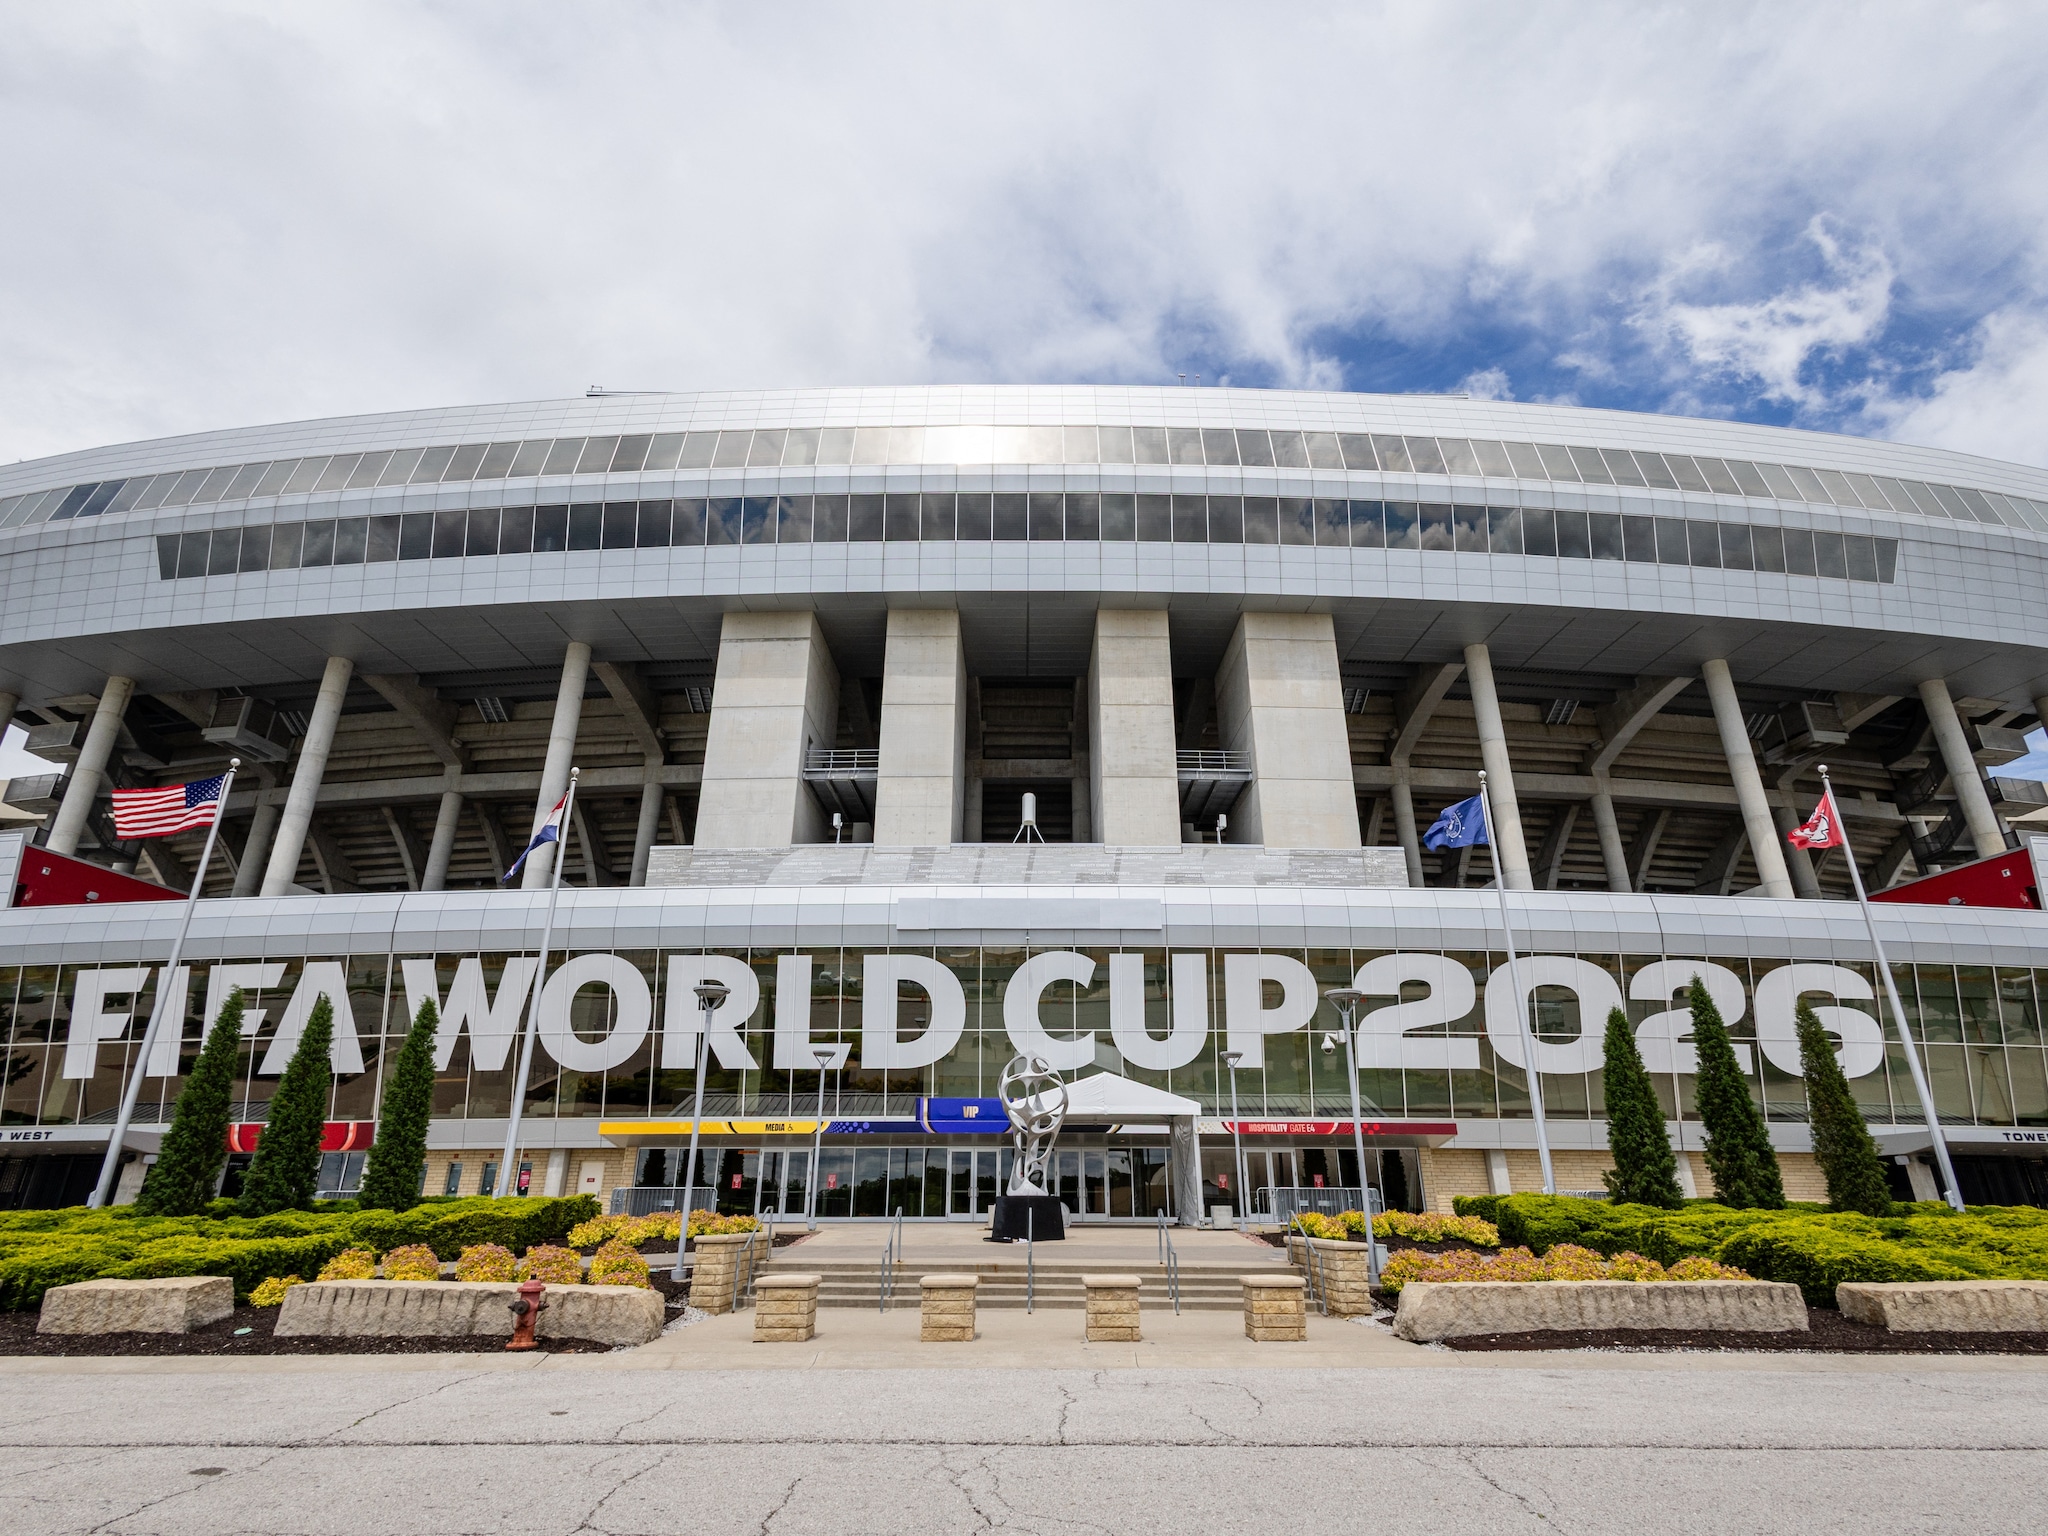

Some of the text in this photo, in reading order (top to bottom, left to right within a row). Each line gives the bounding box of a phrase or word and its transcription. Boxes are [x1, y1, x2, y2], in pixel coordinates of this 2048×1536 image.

[63, 951, 1884, 1079] FIFA WORLD CUP 2026
[962, 1105, 980, 1118] VIP
[765, 1123, 785, 1132] MEDIA
[1248, 1123, 1316, 1133] HOSPITALITY GATE E4
[10, 1131, 53, 1140] WEST
[2002, 1132, 2048, 1142] TOWE
